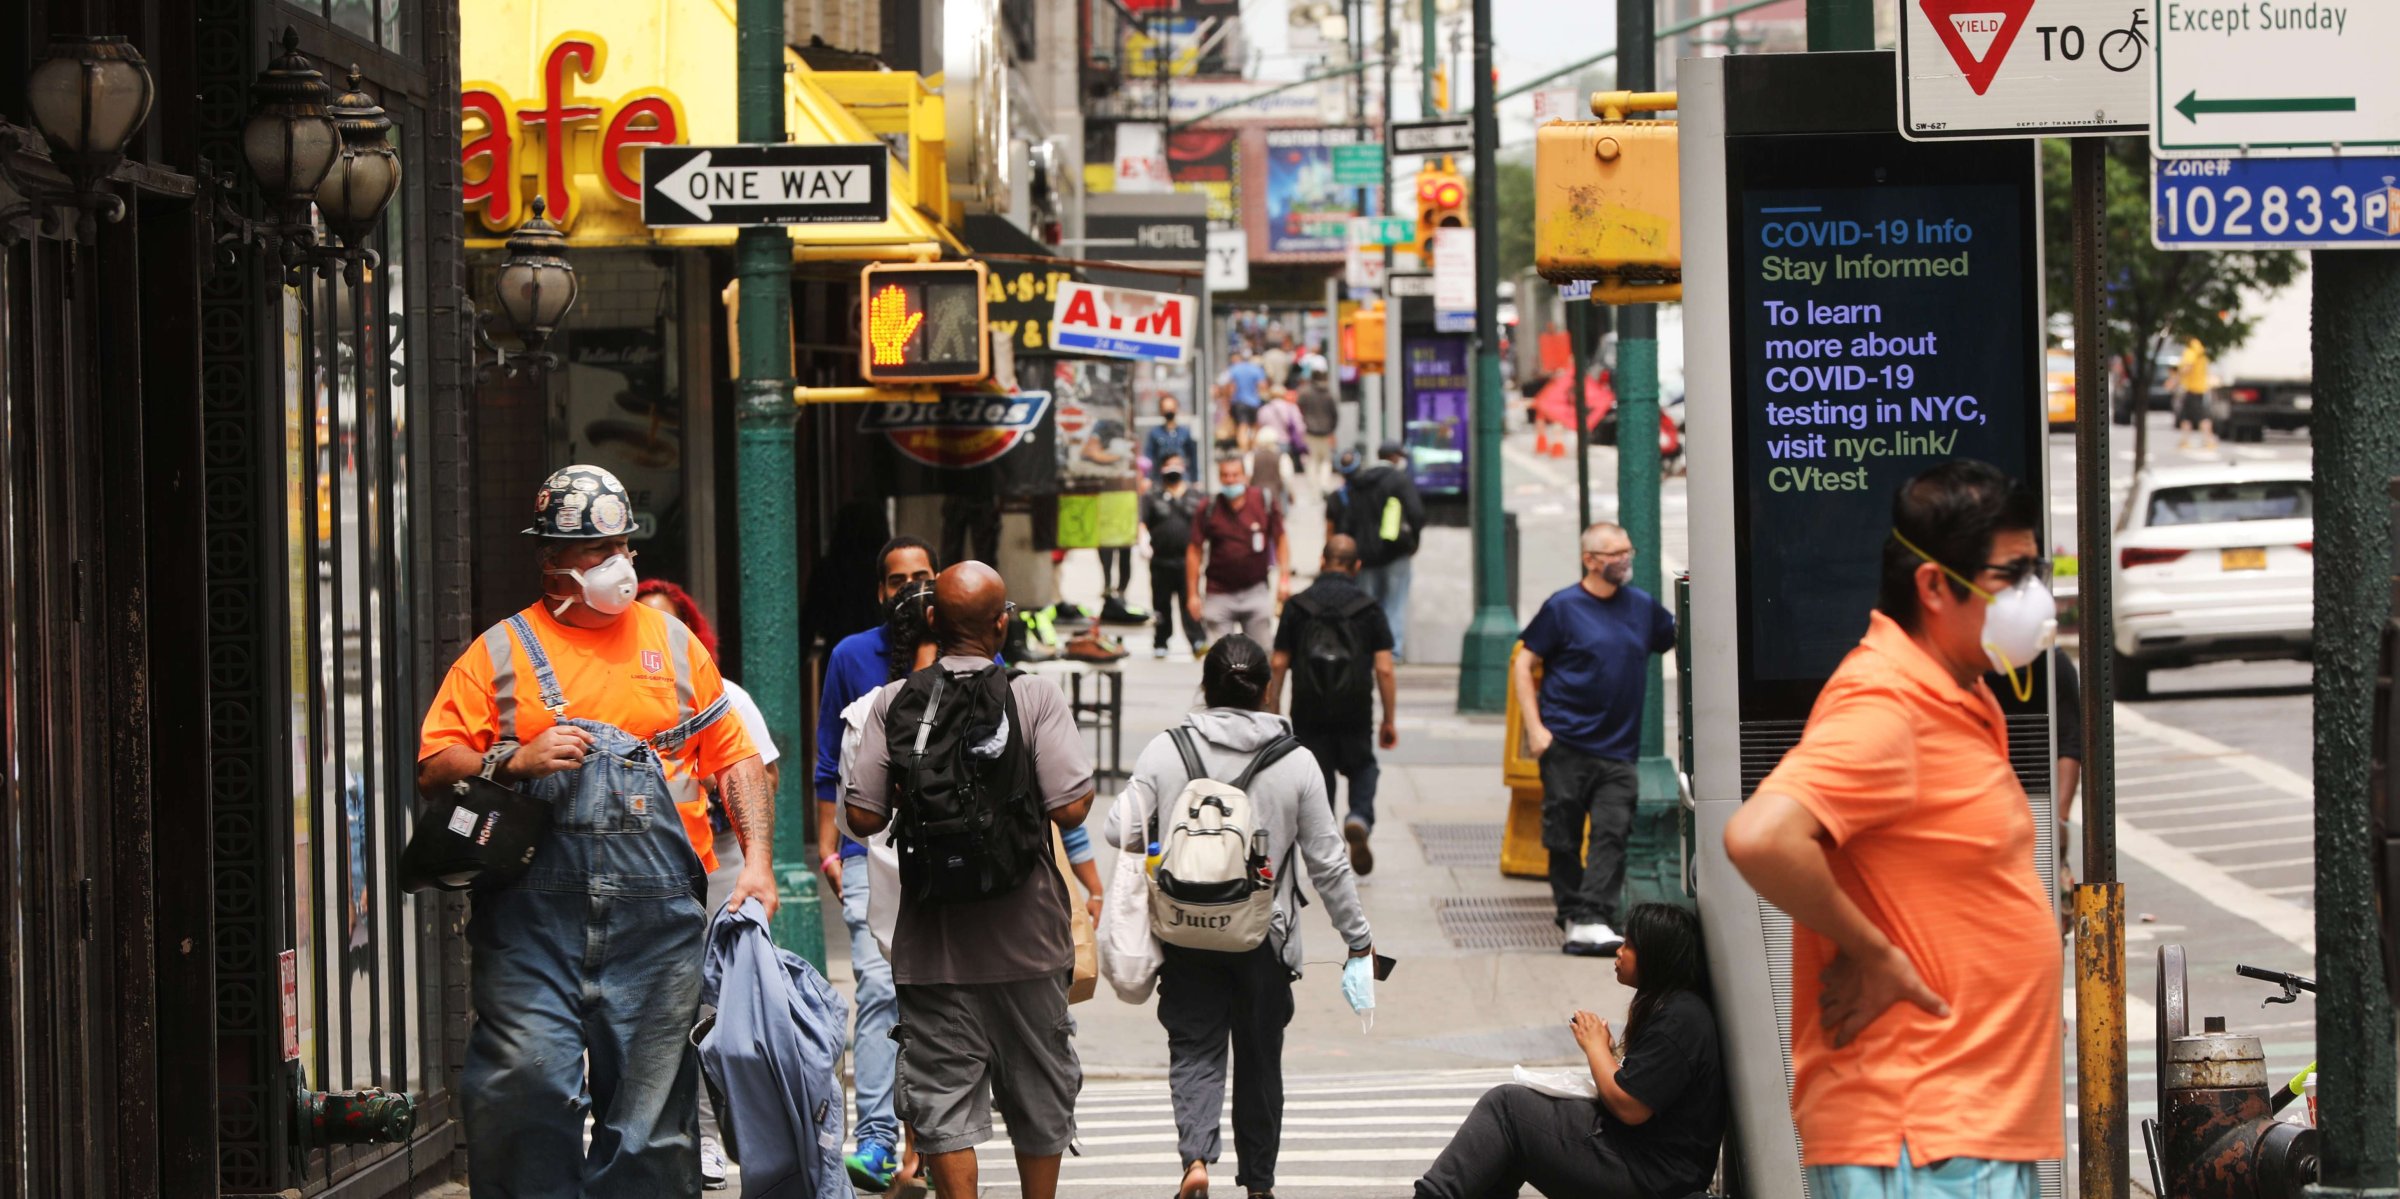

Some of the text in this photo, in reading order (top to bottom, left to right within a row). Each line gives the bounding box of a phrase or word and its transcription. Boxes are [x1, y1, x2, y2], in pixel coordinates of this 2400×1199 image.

[1955, 19, 1999, 33] YIELD
[2169, 2, 2347, 37] Except Sunday
[2036, 25, 2085, 61] TO
[1915, 122, 1947, 130] SW-627
[2164, 159, 2231, 177] Zone#
[689, 170, 853, 200] ONE WAY
[2164, 185, 2358, 236] 102833
[1138, 224, 1200, 248] HOTEL
[1761, 218, 1973, 248] COVID-19 Info
[1761, 251, 1969, 285] Stay Informed
[1763, 300, 1882, 326] To learn
[1766, 331, 1937, 359] more about
[1766, 364, 1915, 393] COVID-19
[880, 397, 1031, 423] Dickies
[1766, 395, 1987, 430] testing in NYC,
[1767, 429, 1959, 463] visit nyc.link/
[1768, 466, 1869, 492] CVtest
[1168, 904, 1231, 932] Juicy
